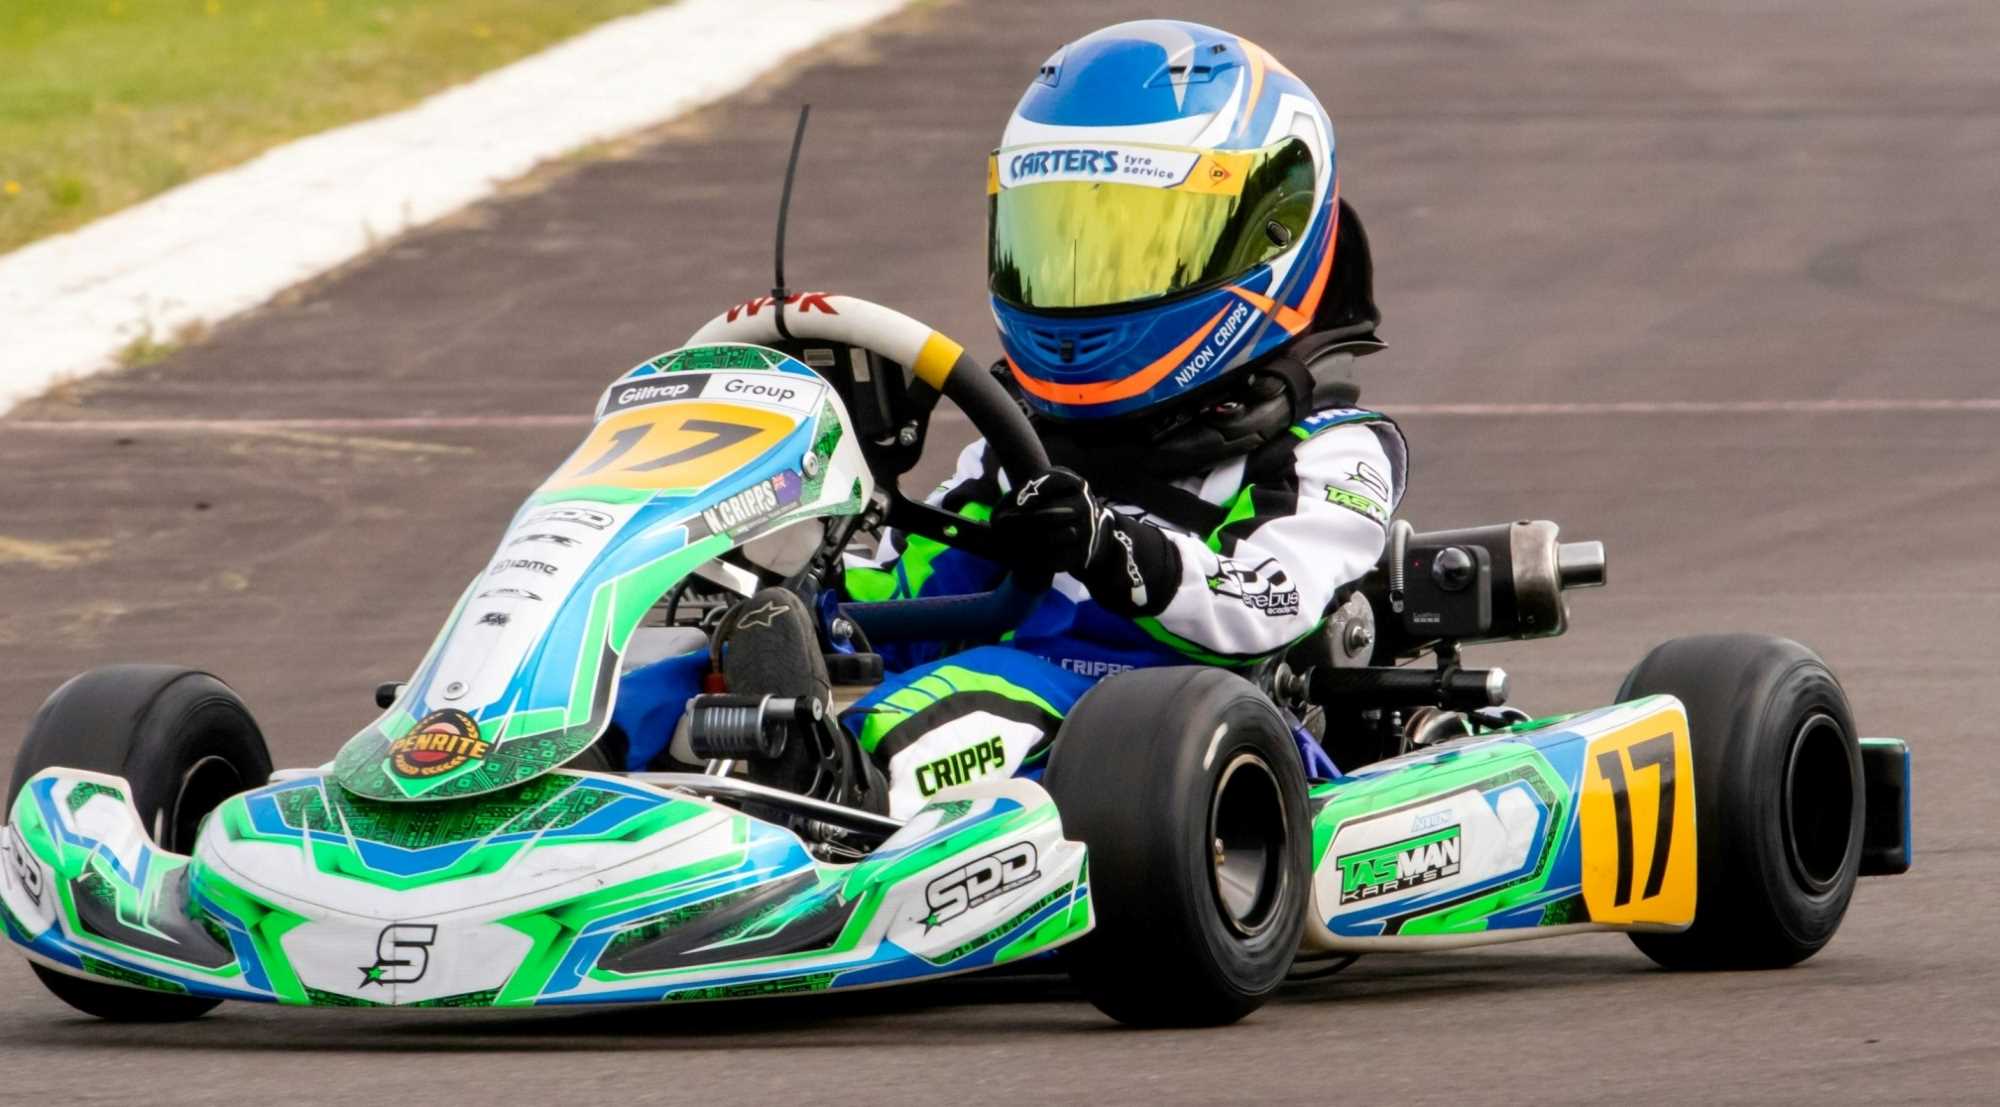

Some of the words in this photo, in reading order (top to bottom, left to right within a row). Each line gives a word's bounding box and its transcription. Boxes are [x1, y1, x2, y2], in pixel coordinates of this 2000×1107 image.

[1010, 149, 1118, 180] CARTER'S
[1123, 166, 1175, 180] service
[1124, 154, 1152, 166] tyre
[1174, 345, 1215, 387] NIXON
[1214, 302, 1248, 346] CRIPPS
[618, 383, 690, 404] Giltrap
[724, 379, 795, 401] Group
[572, 419, 766, 478] 17
[915, 736, 1006, 797] CRIPPS
[1596, 731, 1676, 907] 17
[1337, 826, 1461, 892] TASMAN
[1341, 867, 1438, 903] KARTS
